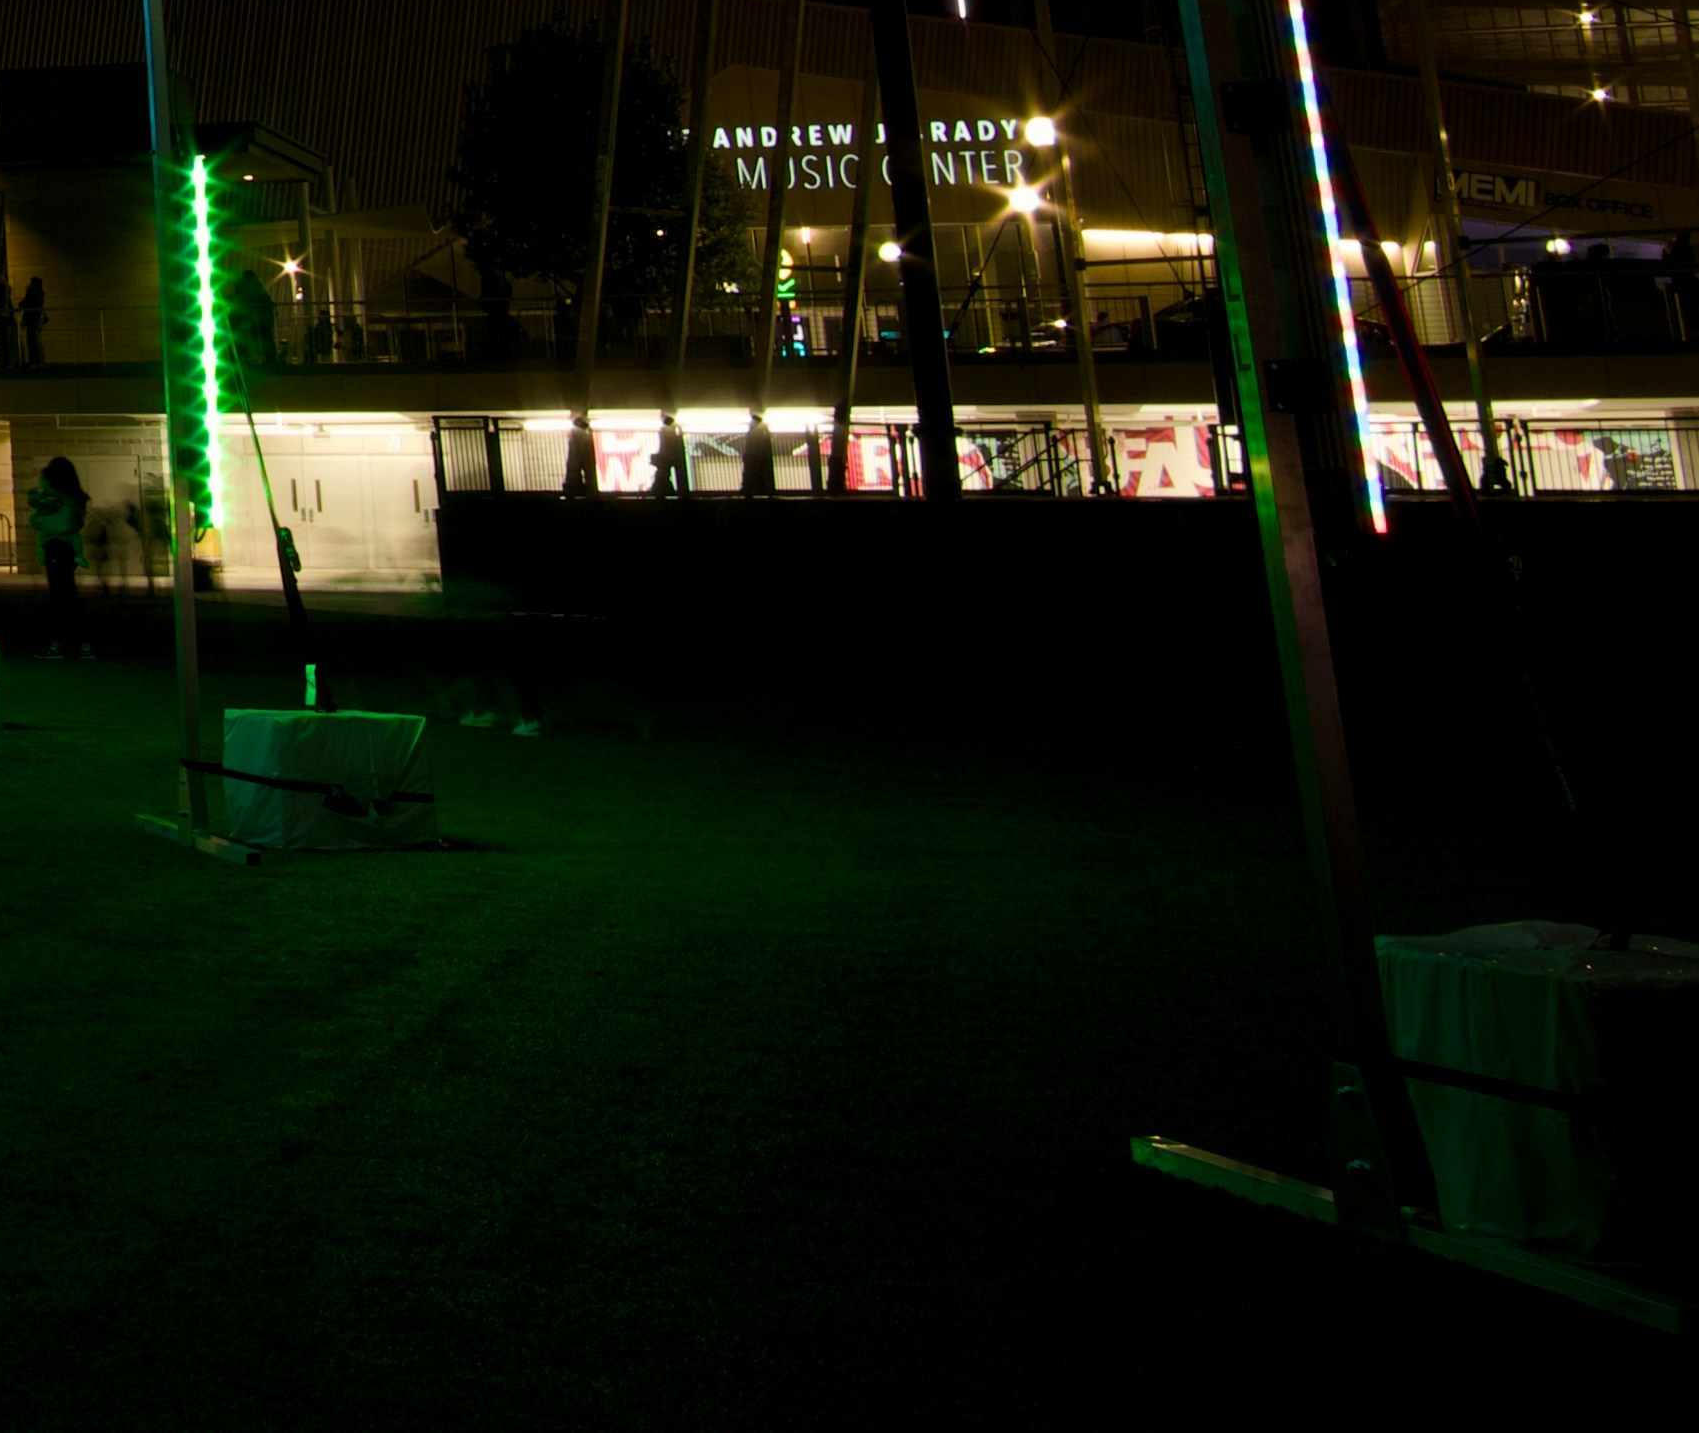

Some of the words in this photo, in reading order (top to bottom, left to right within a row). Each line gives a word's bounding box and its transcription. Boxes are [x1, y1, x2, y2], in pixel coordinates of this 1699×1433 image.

[712, 123, 855, 150] ANDREW
[920, 119, 1018, 144] RADY
[881, 149, 1026, 185] CNTER
[1544, 192, 1582, 211] BOX
[1587, 197, 1654, 219] OFFICE
